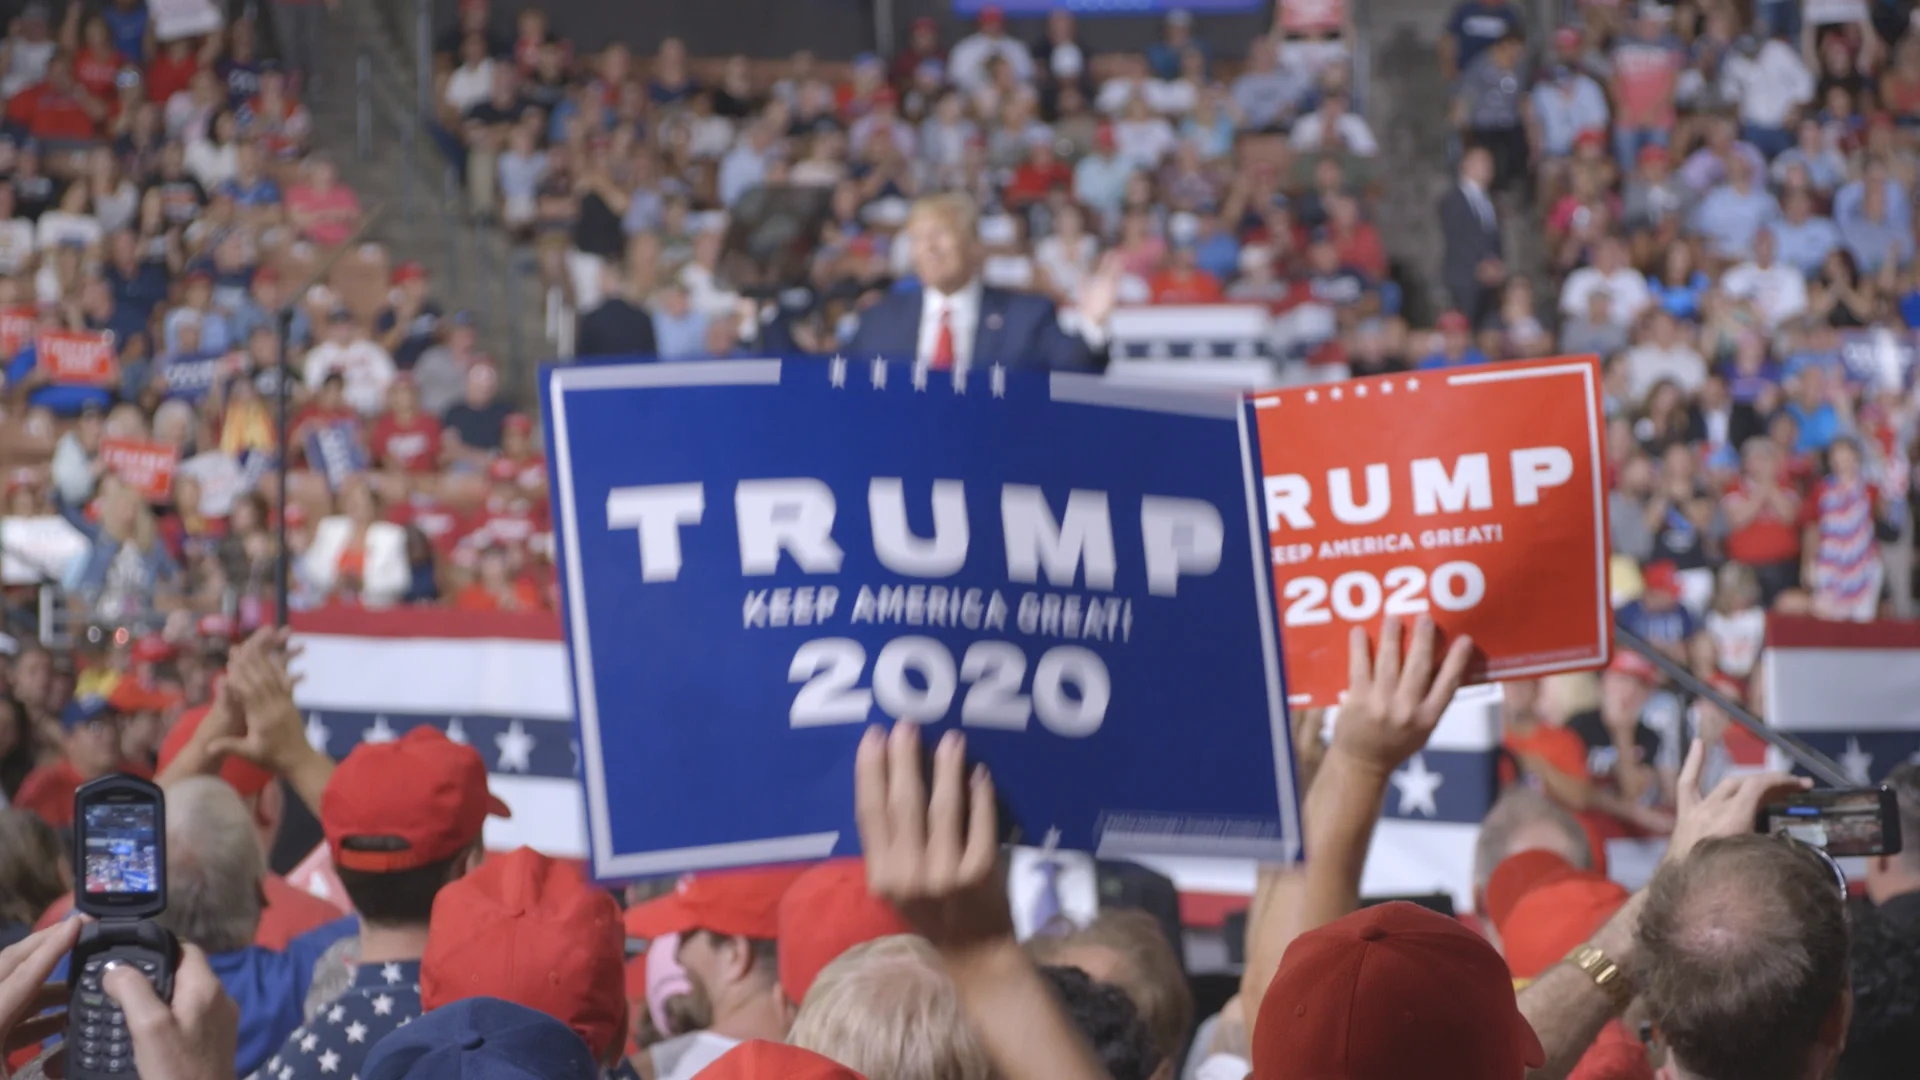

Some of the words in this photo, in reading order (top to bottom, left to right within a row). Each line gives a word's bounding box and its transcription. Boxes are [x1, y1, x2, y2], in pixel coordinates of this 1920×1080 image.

[1263, 446, 1573, 532] RUMP
[607, 476, 1225, 597] TRUMP
[1272, 543, 1313, 565] EEP
[1318, 533, 1415, 559] AMERICA
[1419, 524, 1503, 549] GREAT!
[743, 584, 840, 629] KEEP
[850, 584, 1009, 632] AMERICA
[1017, 591, 1134, 643] GREAT!
[1283, 560, 1486, 627] 2020
[788, 635, 1112, 739] 2020
